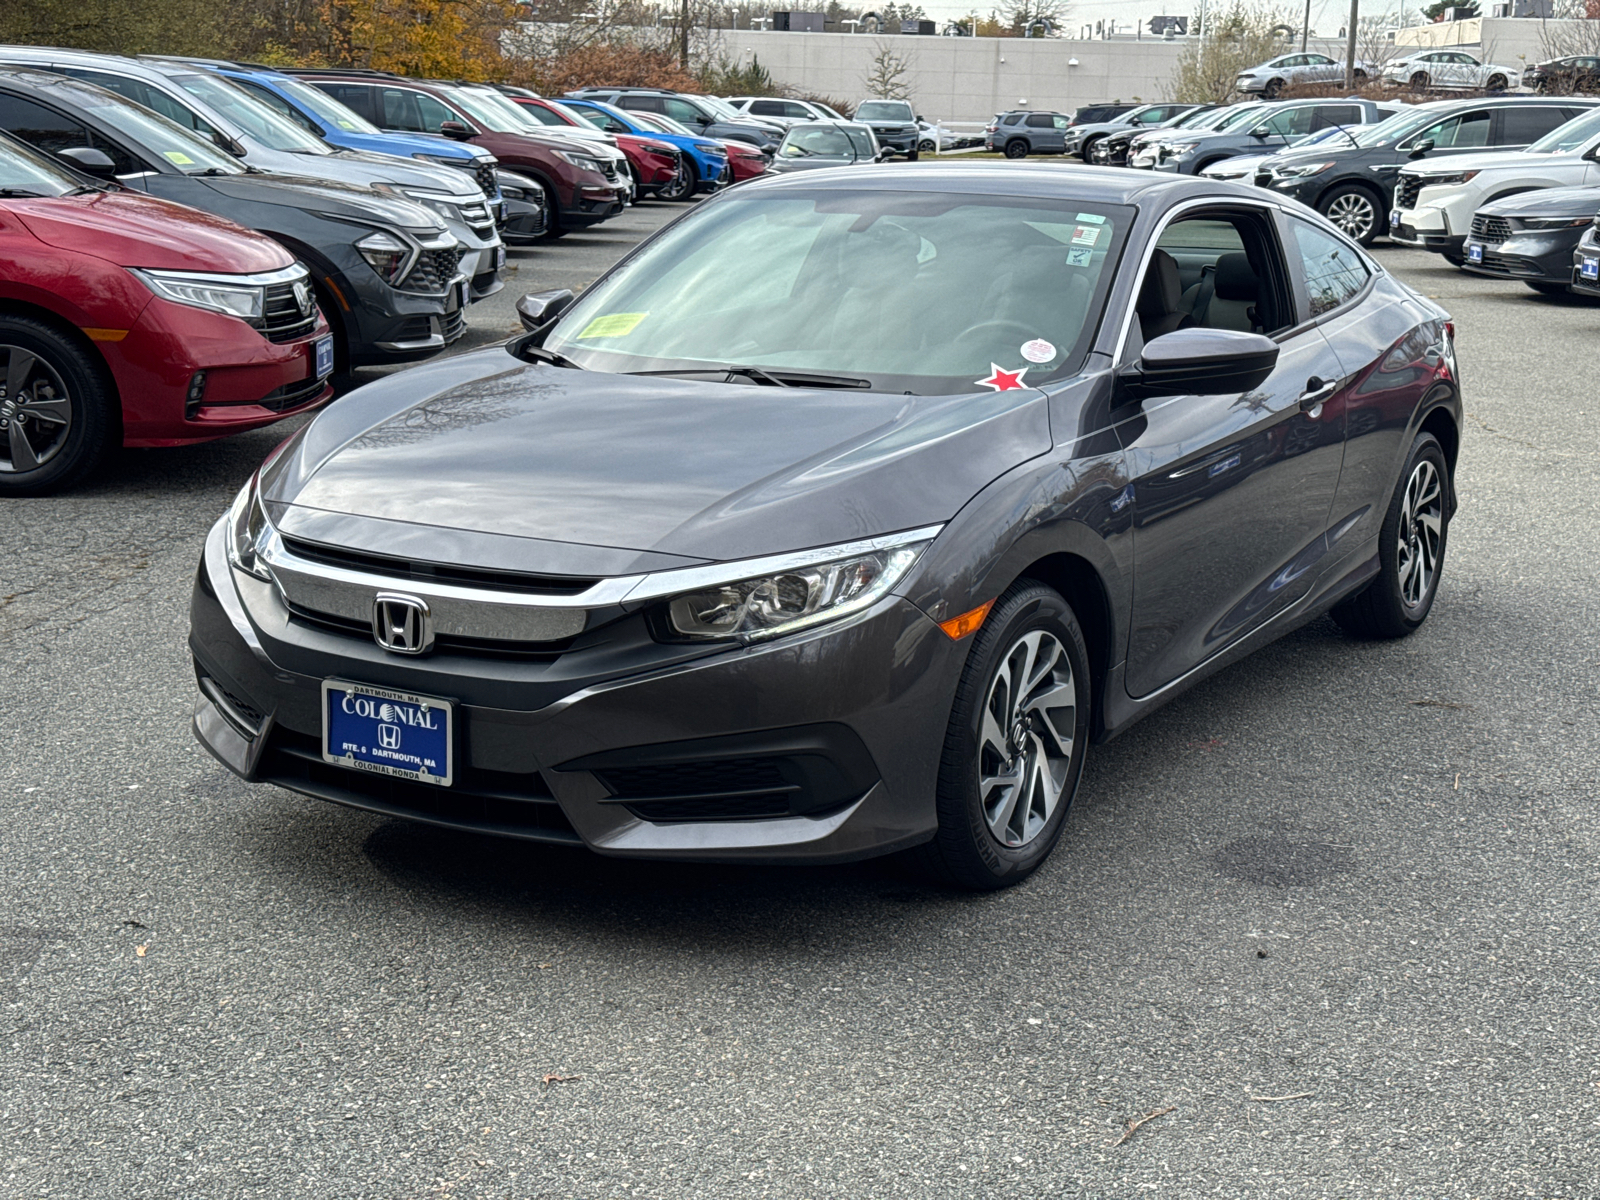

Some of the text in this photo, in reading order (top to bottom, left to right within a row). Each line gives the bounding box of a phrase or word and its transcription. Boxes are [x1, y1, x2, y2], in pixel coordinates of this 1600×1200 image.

[407, 695, 420, 703] MA
[341, 696, 438, 730] COLONIAL
[342, 742, 360, 752] RTE.
[424, 758, 436, 768] MA
[353, 761, 420, 780] COLONIAL HONDA
